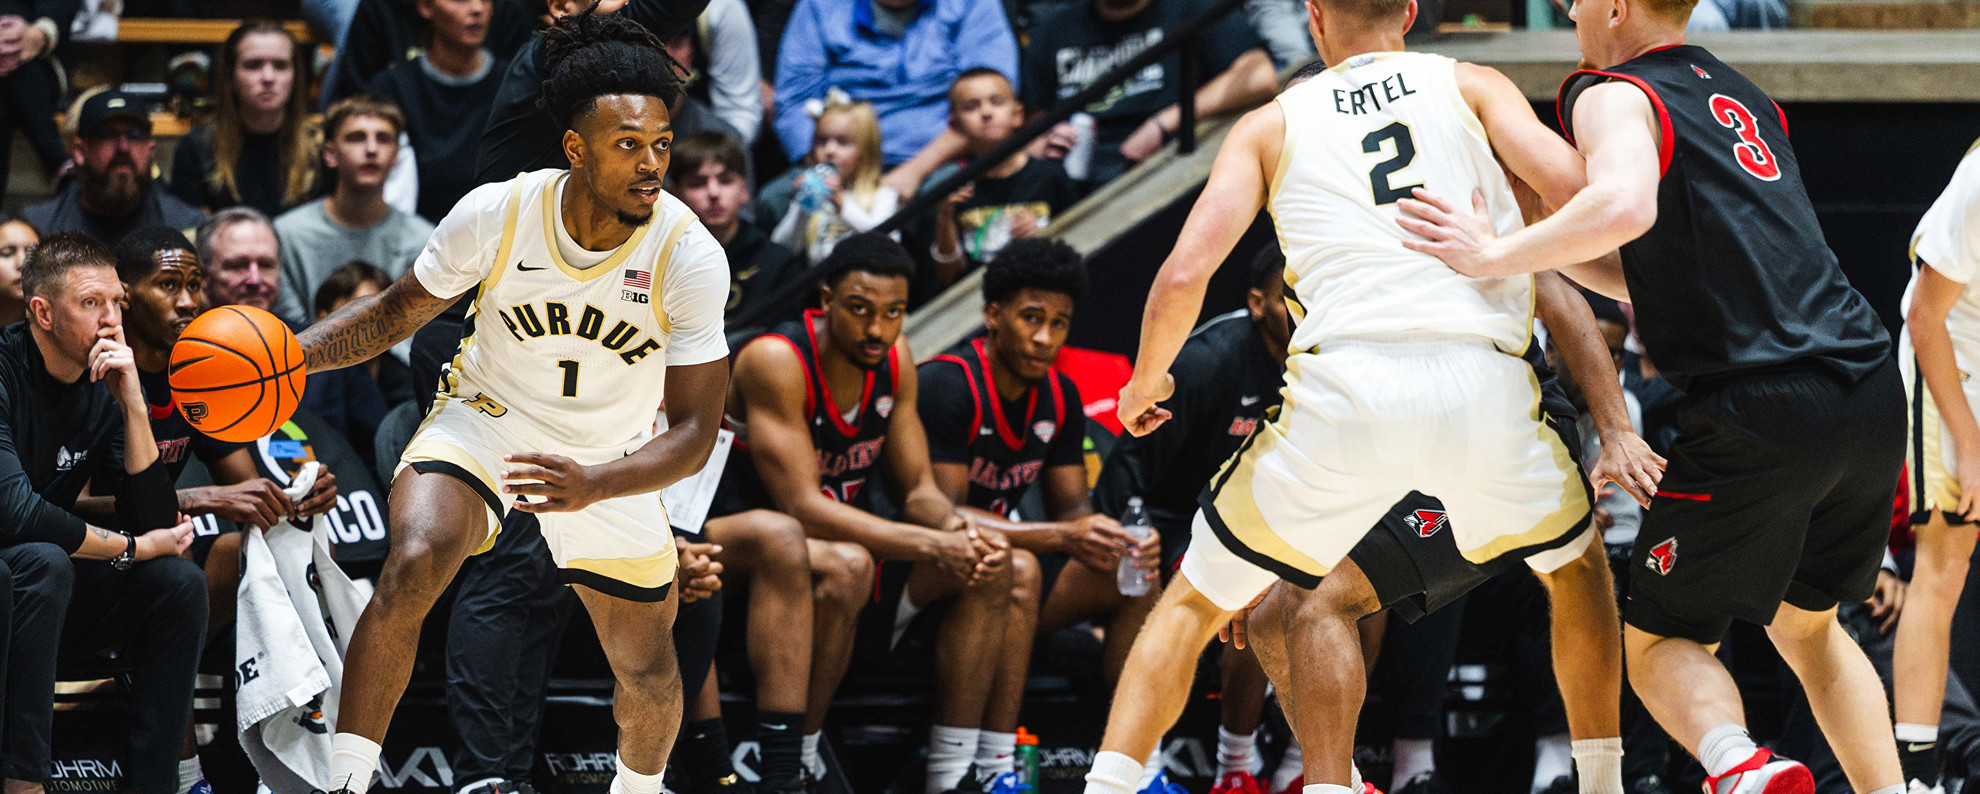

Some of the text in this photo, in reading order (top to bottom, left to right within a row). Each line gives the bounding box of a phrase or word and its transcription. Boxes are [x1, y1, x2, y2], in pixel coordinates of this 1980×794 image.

[1333, 73, 1416, 115] ERTEL
[1361, 119, 1425, 206] 2
[1708, 93, 1781, 181] 3
[498, 300, 663, 366] PURDUE
[556, 359, 581, 398] 1
